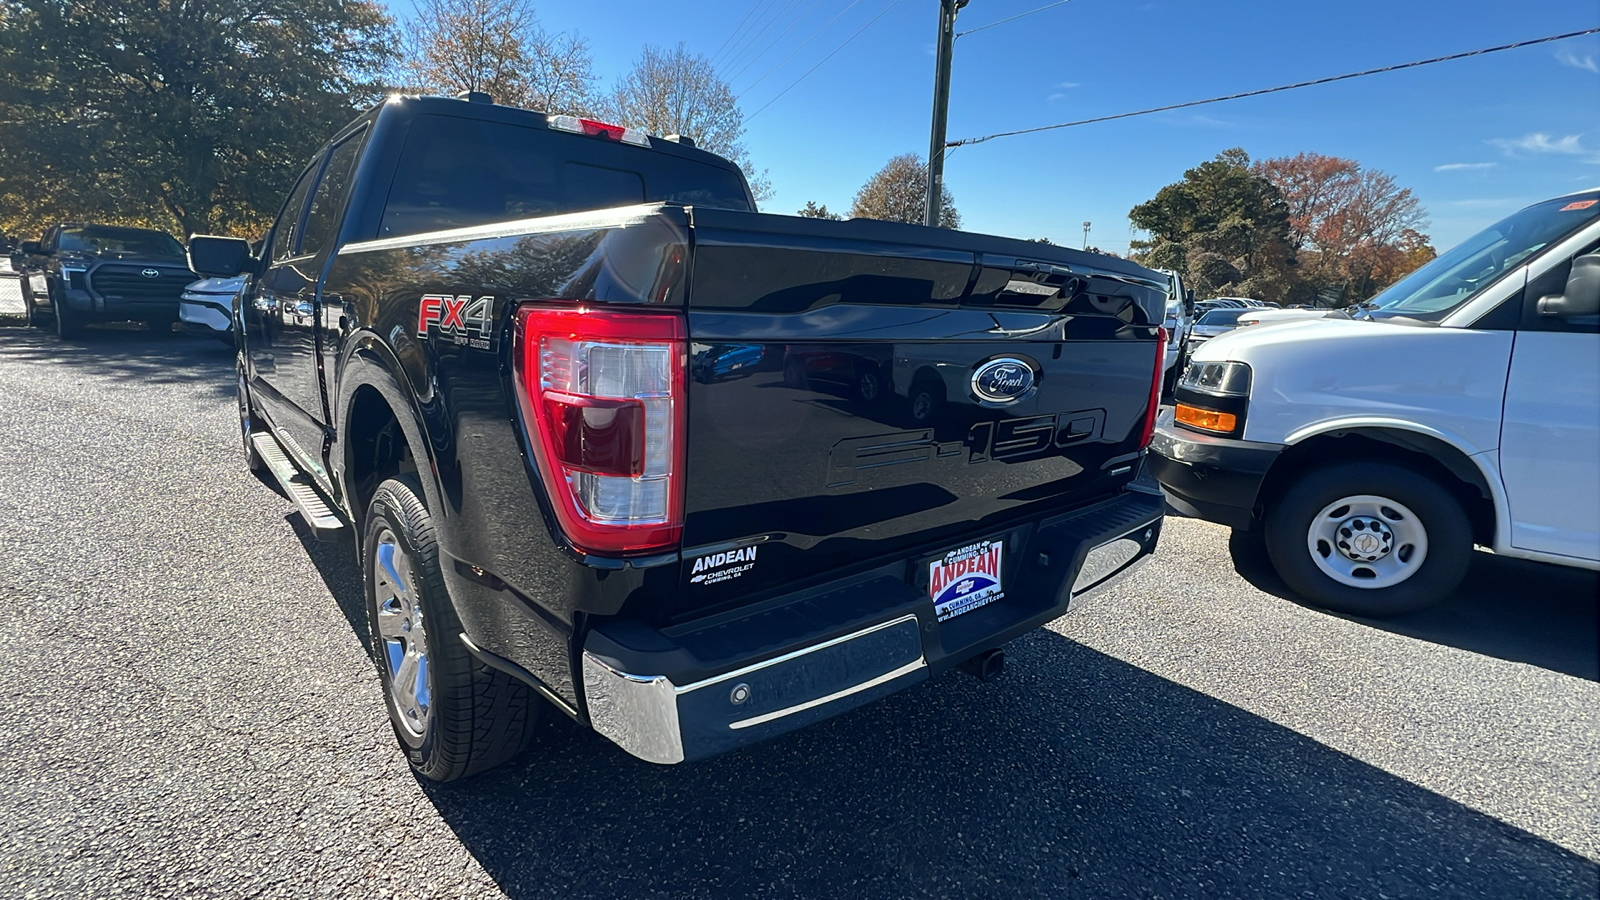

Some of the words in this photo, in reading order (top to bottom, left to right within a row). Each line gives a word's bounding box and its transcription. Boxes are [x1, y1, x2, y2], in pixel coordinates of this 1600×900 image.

[417, 294, 494, 339] FX4
[989, 365, 1024, 392] Ford
[825, 407, 1108, 488] F-150
[691, 546, 757, 574] ANDEAN
[957, 543, 980, 555] ANDEAN
[707, 563, 754, 579] CHEVROLET
[931, 547, 998, 600] ANDEAN
